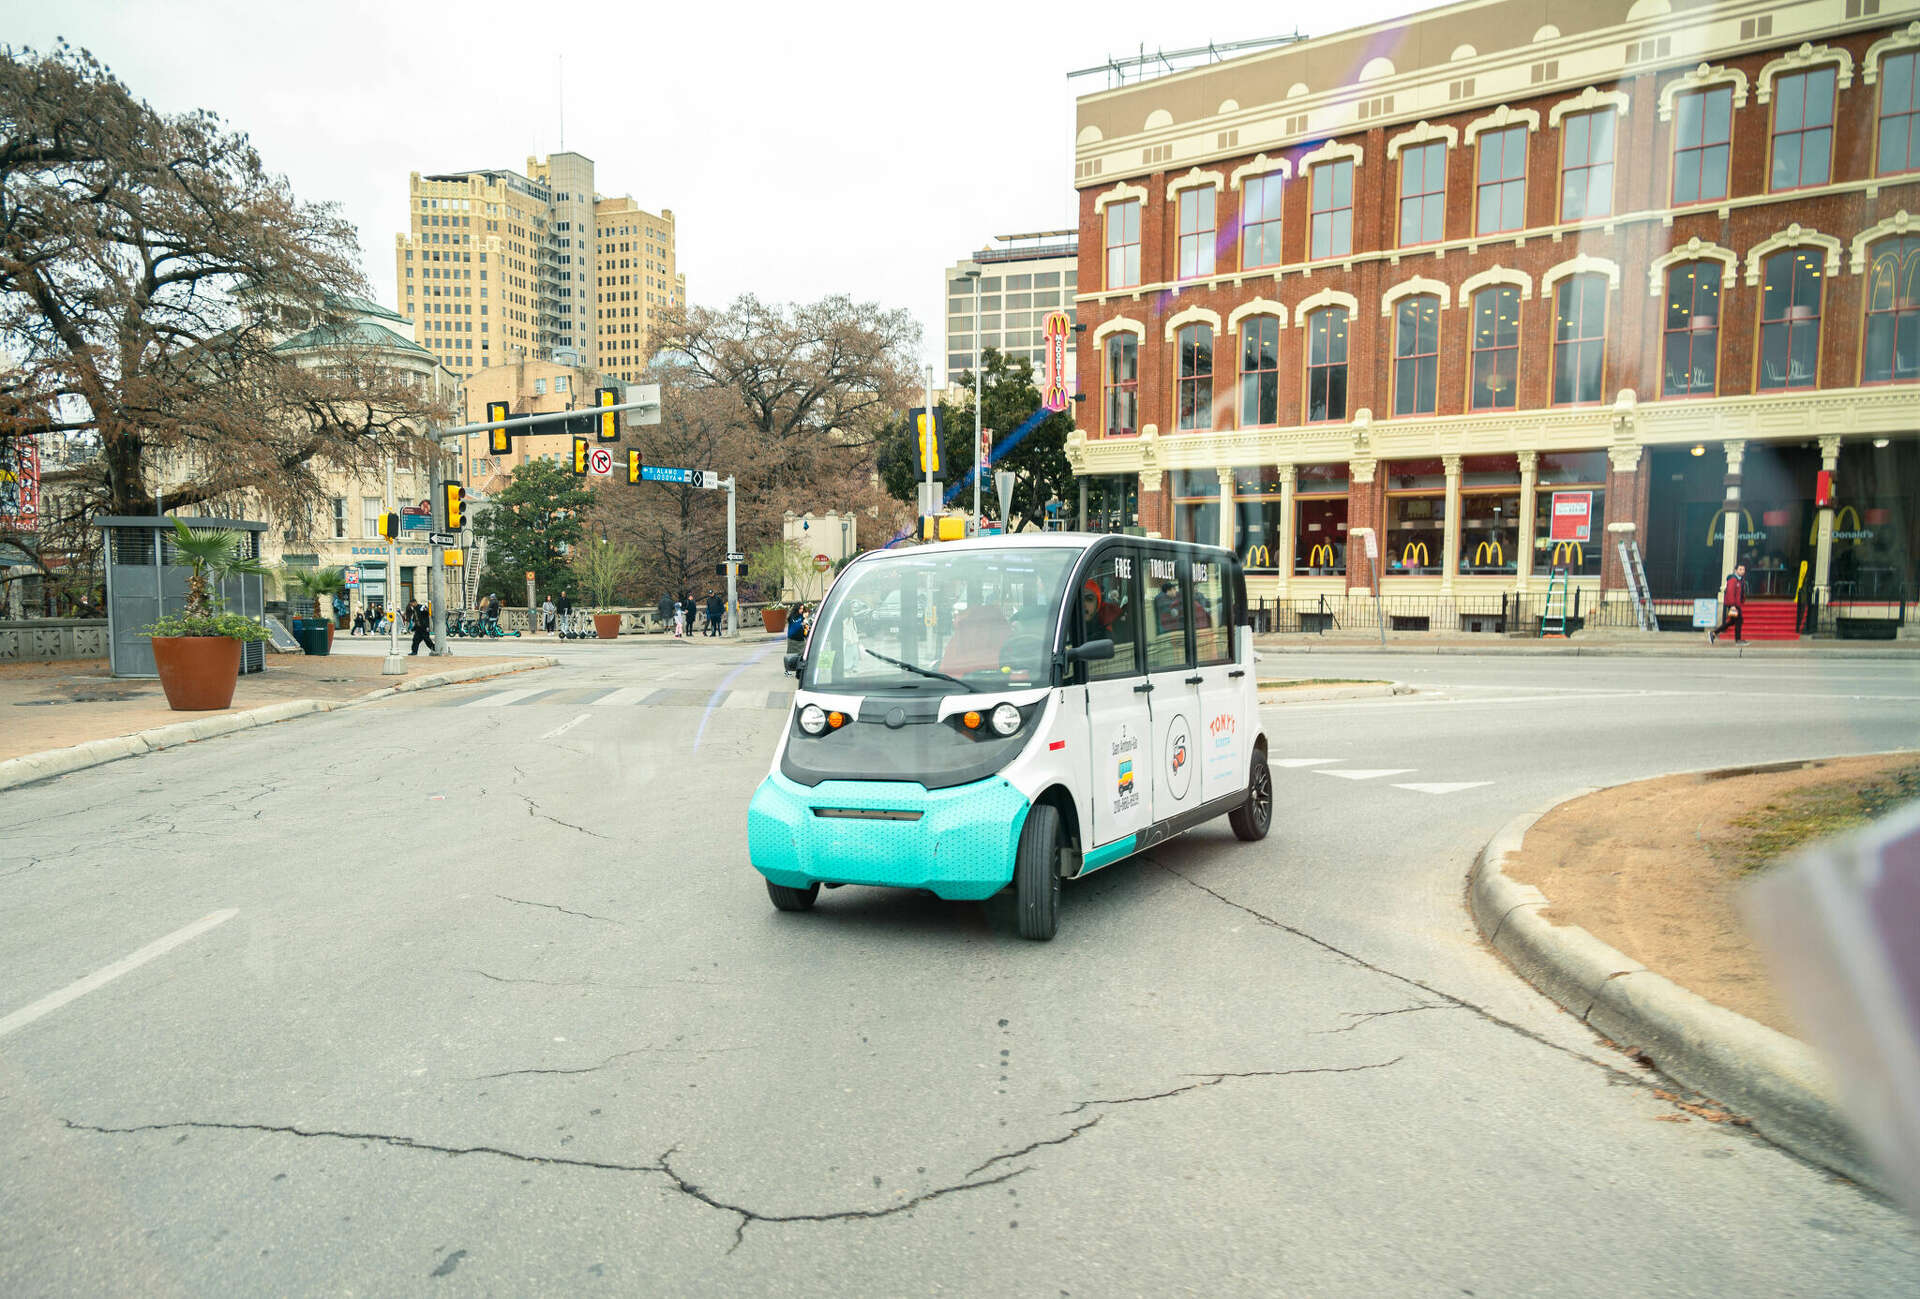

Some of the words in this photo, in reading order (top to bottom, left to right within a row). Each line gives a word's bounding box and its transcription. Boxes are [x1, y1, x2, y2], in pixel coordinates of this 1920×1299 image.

[1115, 557, 1132, 579] FREE
[1150, 558, 1176, 580] TROLLEY
[1192, 562, 1208, 582] RIDES
